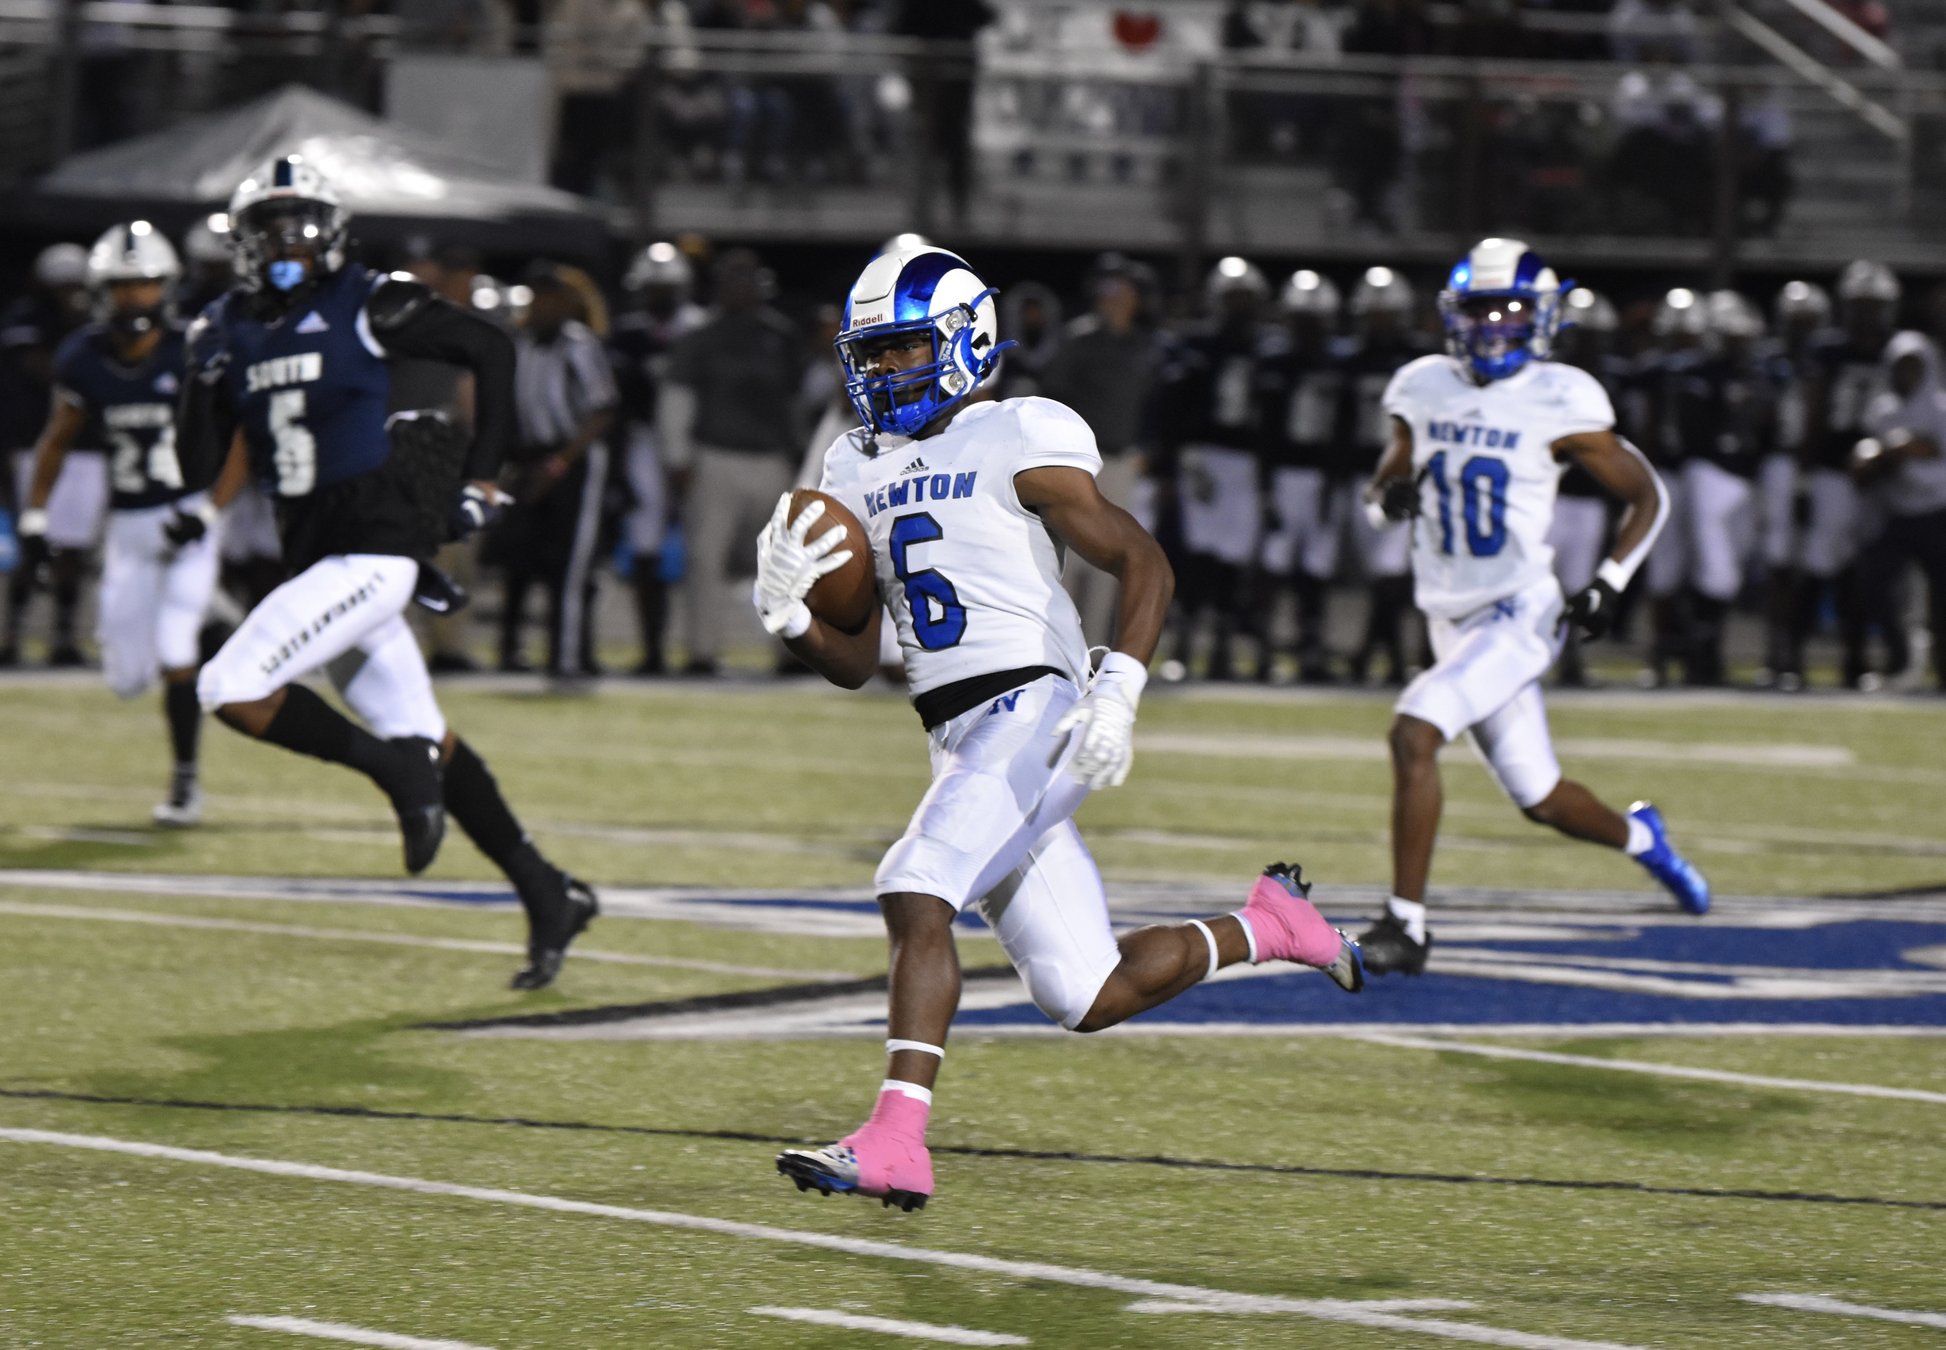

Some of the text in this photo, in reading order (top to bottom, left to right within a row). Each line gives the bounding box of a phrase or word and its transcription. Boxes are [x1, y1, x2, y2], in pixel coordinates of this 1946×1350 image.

[853, 313, 883, 327] Riddell
[1427, 420, 1520, 449] NEWTON
[863, 470, 978, 518] NEWTON
[1427, 450, 1511, 558] 10
[889, 511, 967, 653] 6
[988, 689, 1026, 716] N
